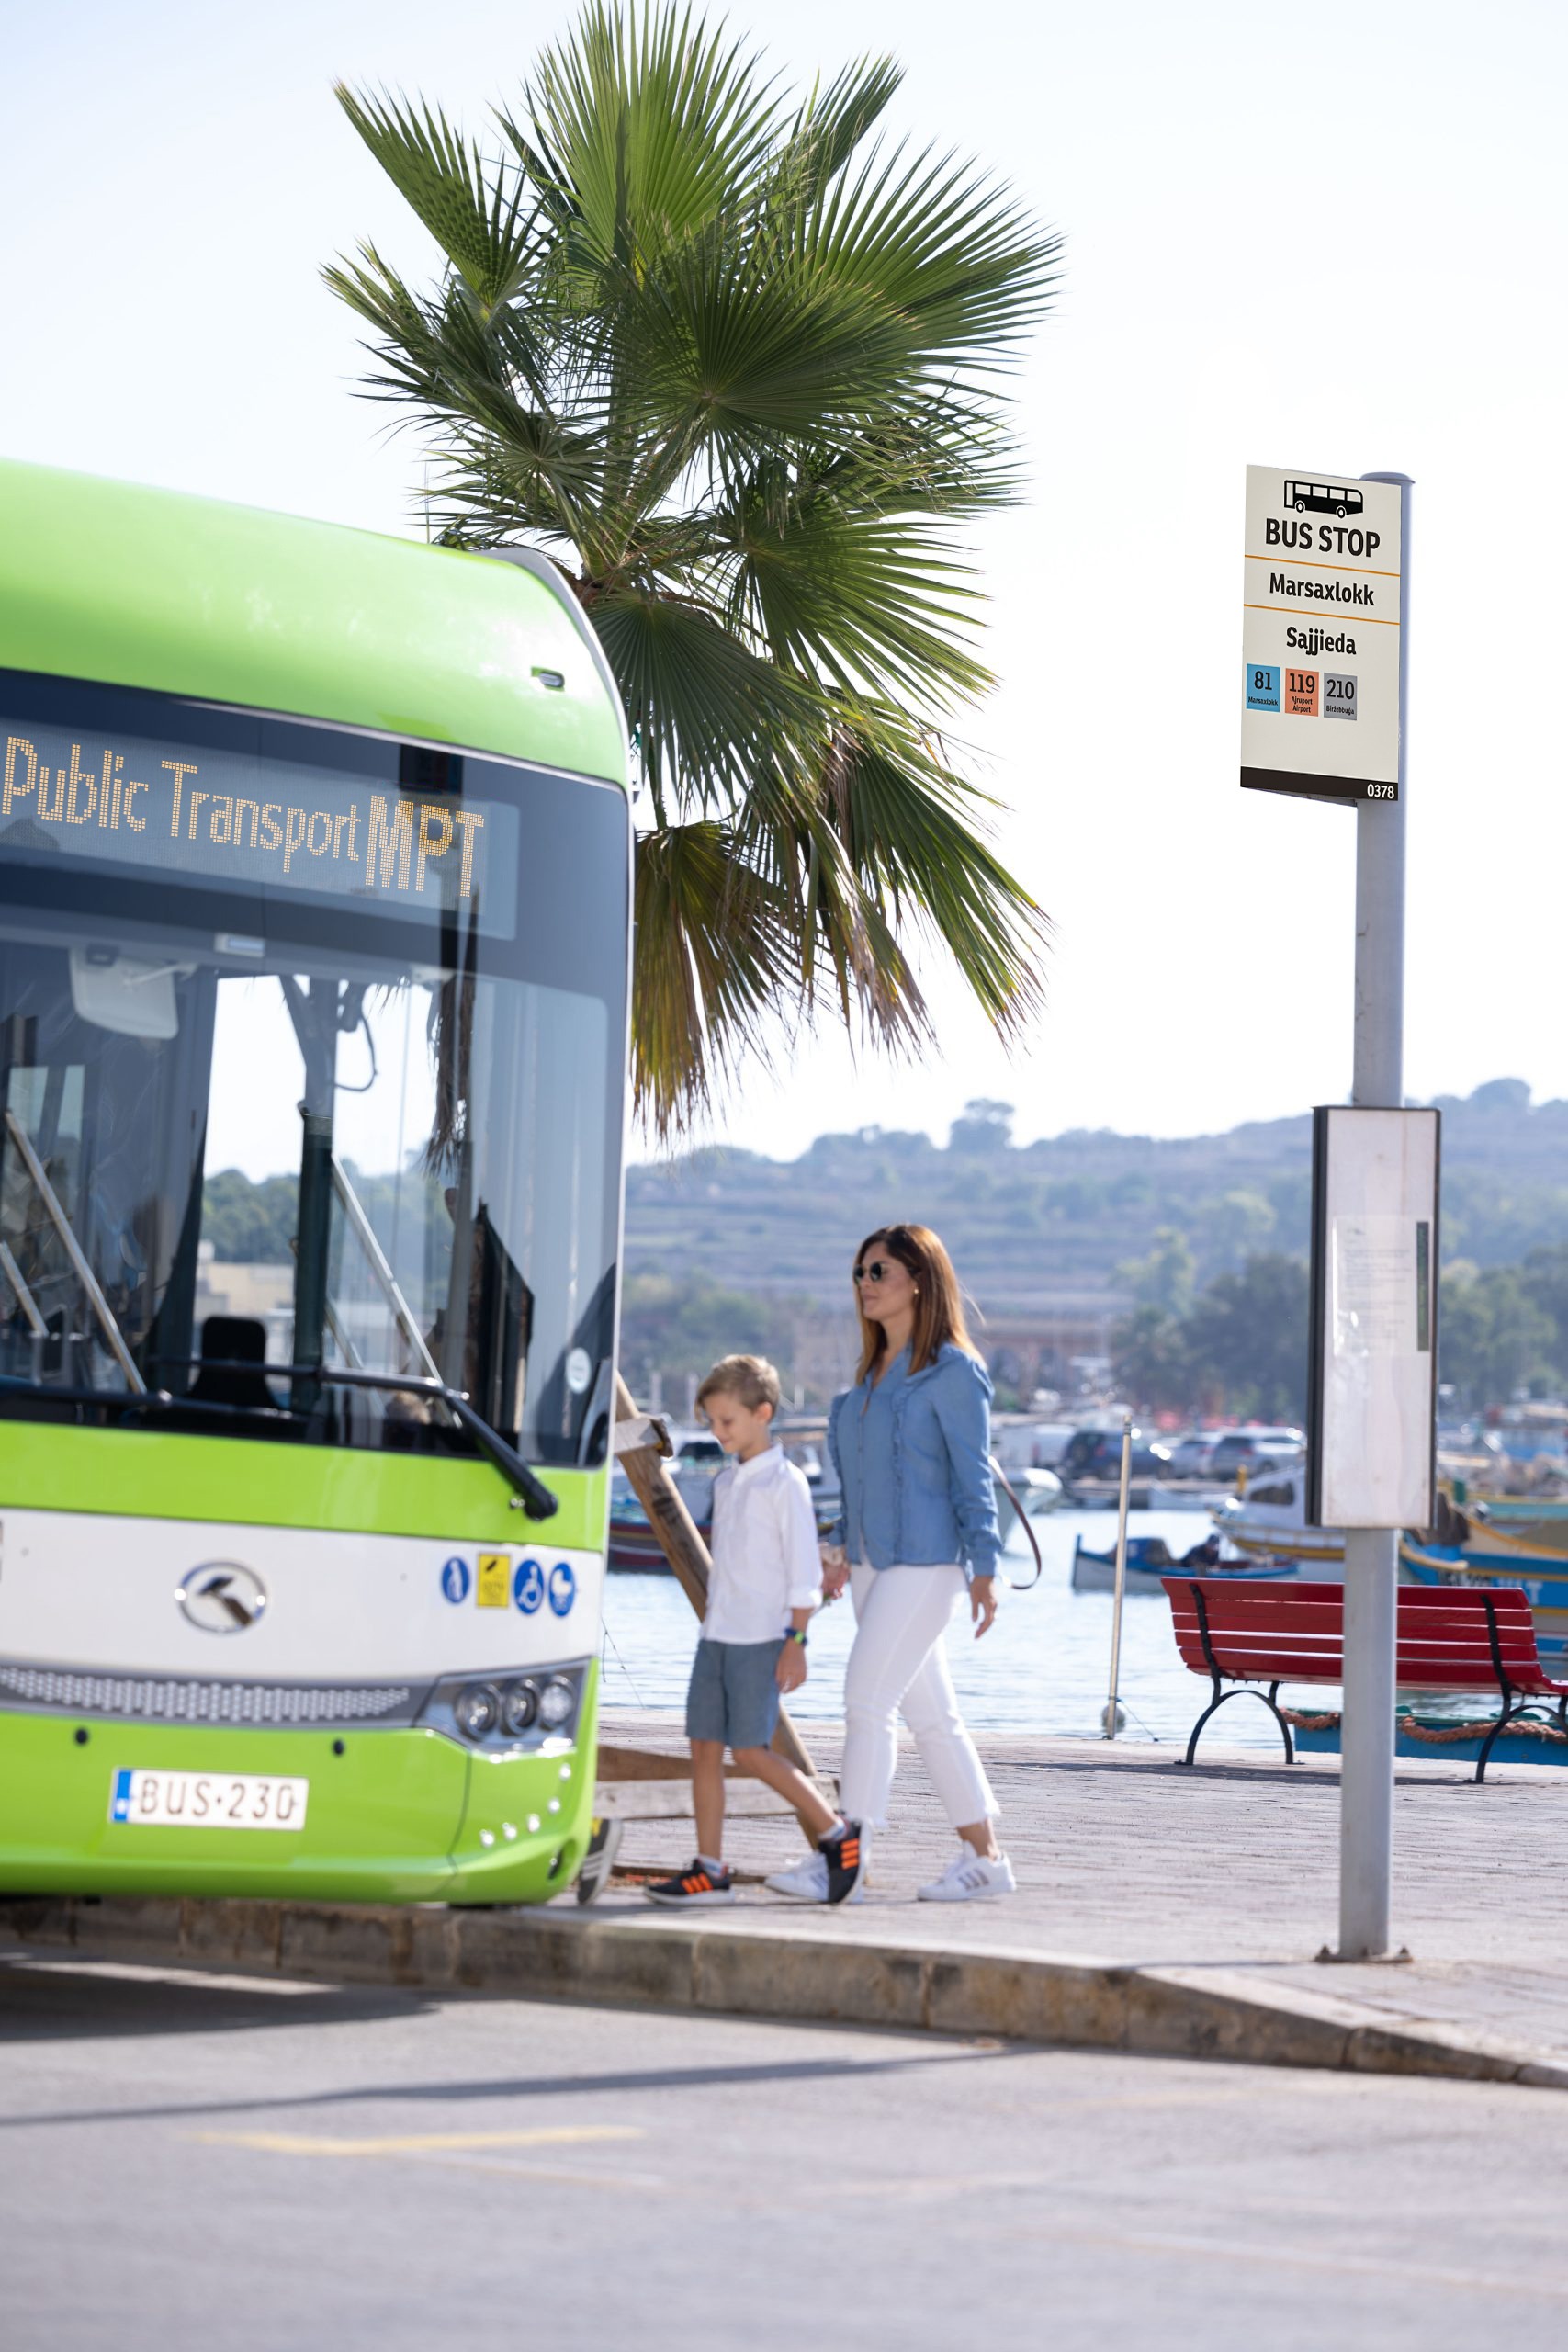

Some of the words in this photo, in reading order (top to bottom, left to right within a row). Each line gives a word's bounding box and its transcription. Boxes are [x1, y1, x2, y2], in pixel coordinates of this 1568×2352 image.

[1265, 517, 1313, 550] BUS
[1318, 525, 1381, 558] STOP
[1269, 572, 1375, 606] Marsaxlokk
[1286, 626, 1357, 656] Sajjieda
[1254, 670, 1272, 691] 81
[1289, 673, 1315, 694] 119
[1326, 678, 1355, 700] 210
[1247, 695, 1279, 707] Marsaxlokk
[1292, 705, 1312, 713] Airport
[1367, 783, 1395, 799] 0378
[2, 736, 150, 832] Public
[161, 760, 362, 873] Transport
[365, 795, 485, 898] MPT
